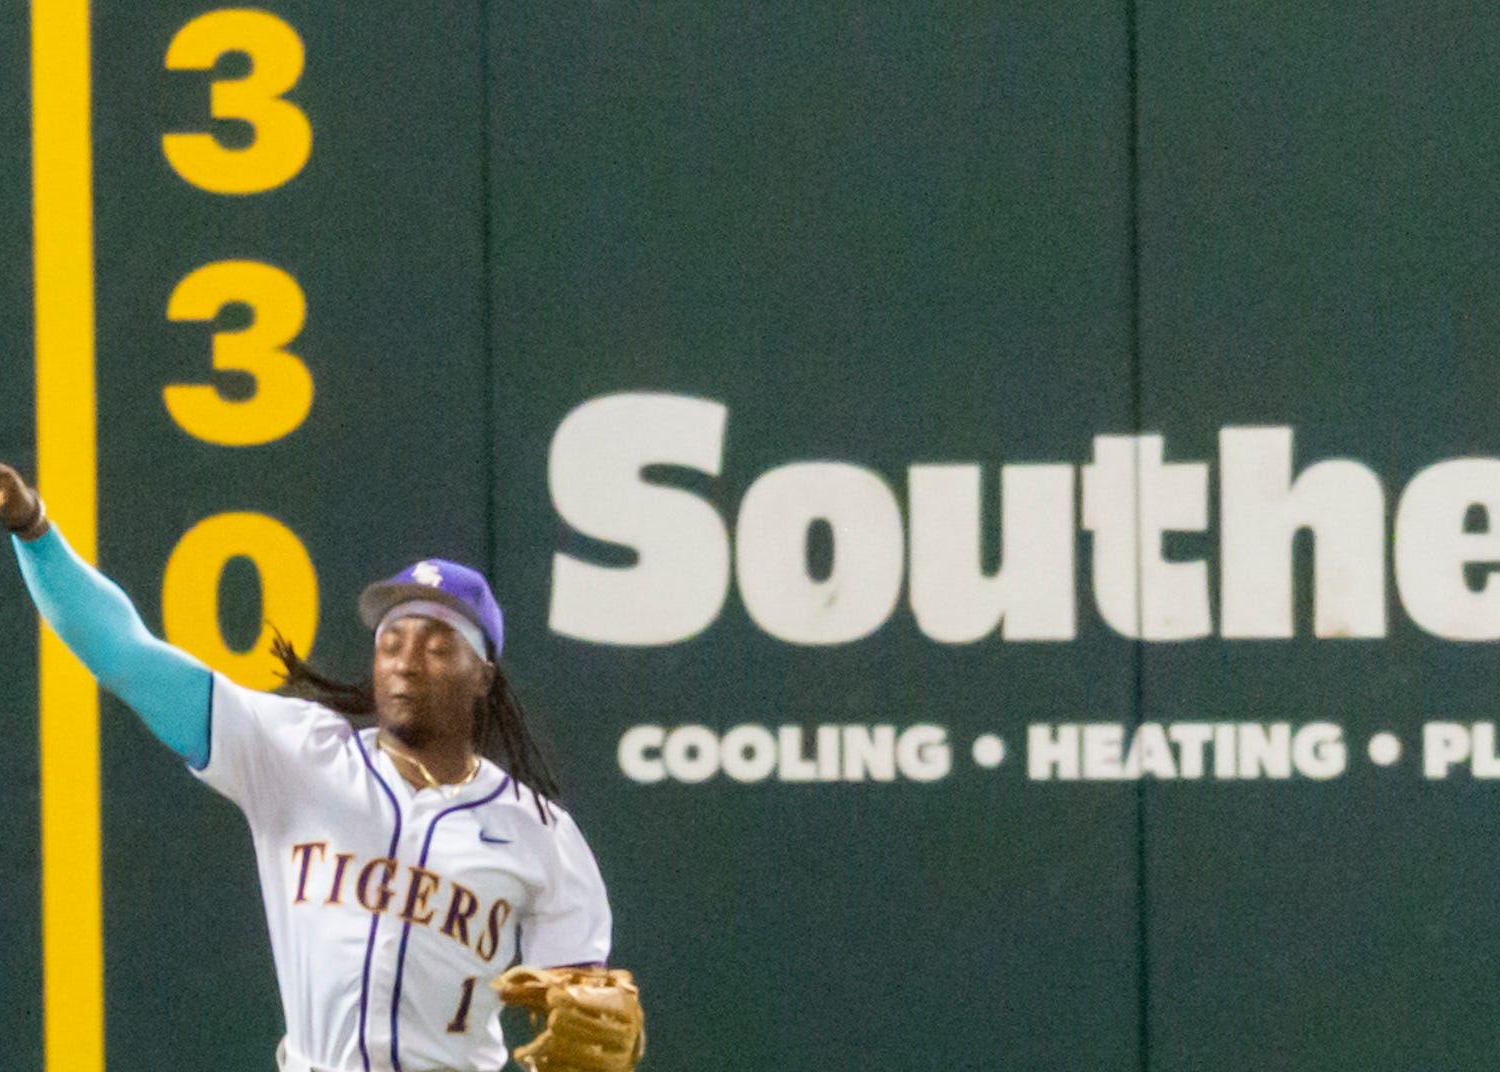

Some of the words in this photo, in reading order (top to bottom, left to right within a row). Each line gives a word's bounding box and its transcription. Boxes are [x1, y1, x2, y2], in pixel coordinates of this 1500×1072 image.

[161, 8, 319, 693] 330
[548, 391, 1500, 647] Southe
[617, 723, 952, 784] COOLING
[1027, 721, 1347, 782] HEATING
[1422, 720, 1500, 781] PL
[292, 842, 511, 962] TIGERS
[448, 977, 476, 1033] 1
